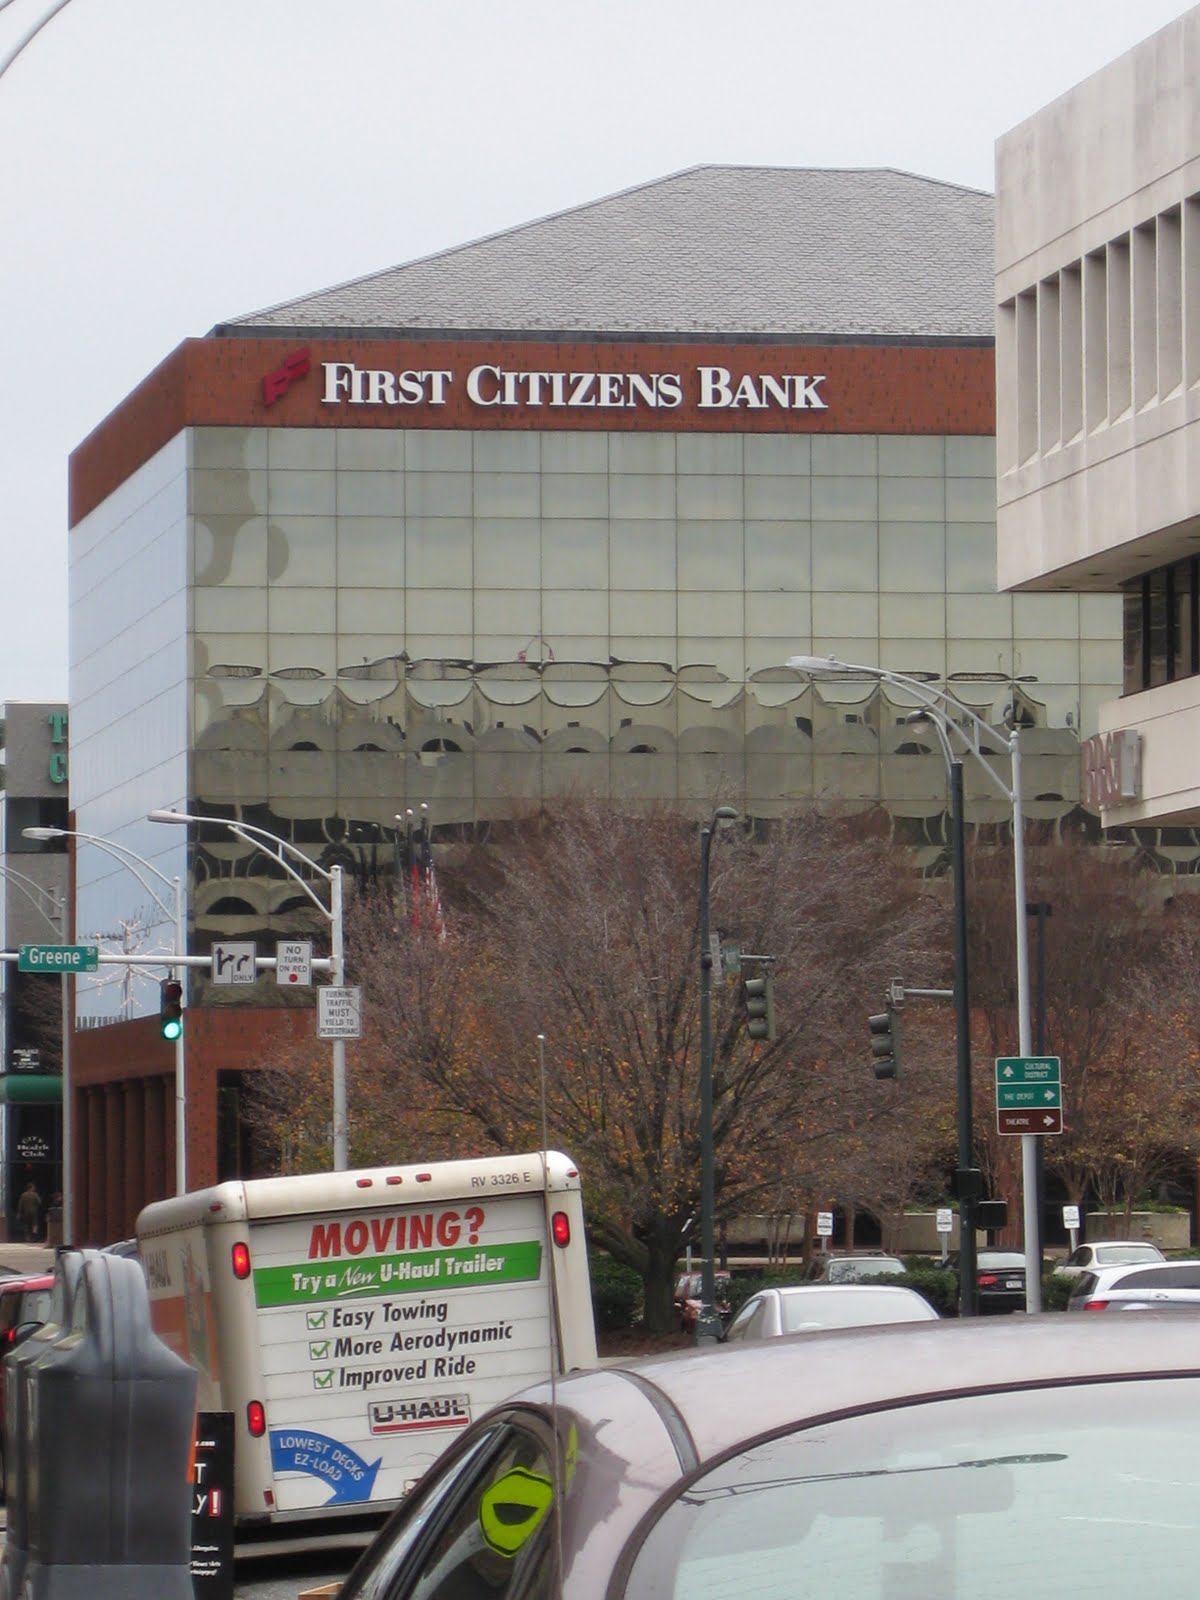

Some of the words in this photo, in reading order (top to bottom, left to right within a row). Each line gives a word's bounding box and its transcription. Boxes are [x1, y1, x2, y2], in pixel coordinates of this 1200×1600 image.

[321, 362, 452, 405] FIRST
[467, 365, 682, 408] CITIZENS
[697, 367, 828, 408] BANK
[20, 947, 26, 955] S
[29, 948, 81, 965] Greene
[286, 946, 301, 954] NO
[233, 974, 253, 982] ONLY
[292, 965, 308, 973] RED
[325, 1018, 344, 1026] YIELD
[346, 1018, 355, 1026] TO
[328, 1008, 350, 1017] MUST
[1024, 1071, 1049, 1079] DISTRICT
[1016, 1092, 1034, 1100] DEPOT
[471, 1176, 486, 1187] RV
[491, 1173, 519, 1186] 3326
[523, 1172, 531, 1183] E
[308, 1207, 485, 1259] MOVING?
[292, 1272, 323, 1295] Try
[325, 1275, 337, 1288] a
[338, 1265, 376, 1288] New
[380, 1260, 440, 1283] U-Haul
[445, 1253, 505, 1276] Trailer
[333, 1308, 374, 1330] Easy
[383, 1300, 448, 1323] Towing
[334, 1338, 383, 1358] More
[390, 1321, 513, 1351] Aerodynamic
[339, 1359, 427, 1390] Improved
[434, 1355, 476, 1377] Ride
[373, 1399, 466, 1423] U-HAUL
[280, 1437, 330, 1454] LOWEST
[331, 1449, 365, 1481] DECKS
[294, 1452, 342, 1481] EZ-LOAD
